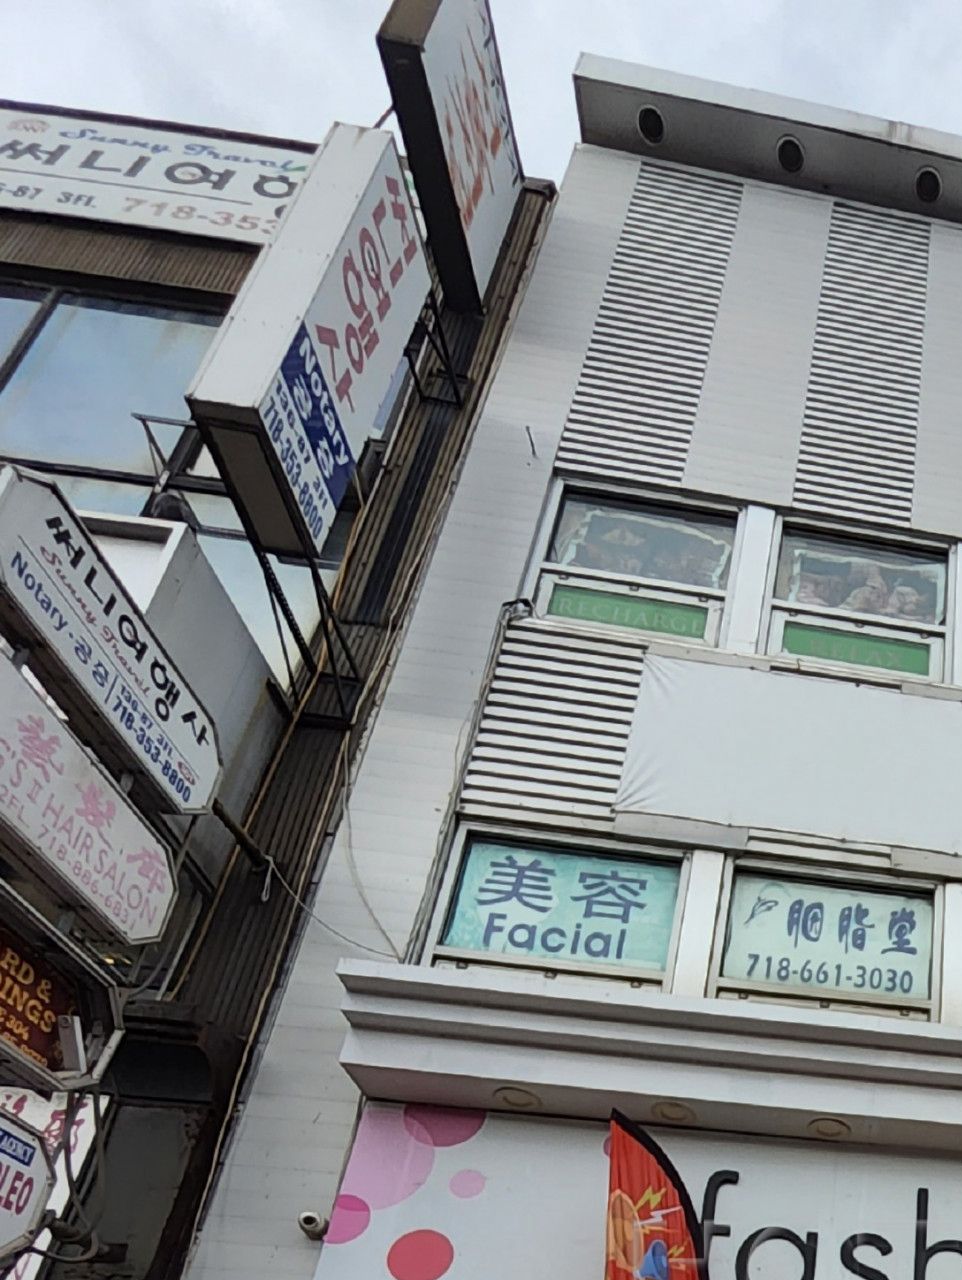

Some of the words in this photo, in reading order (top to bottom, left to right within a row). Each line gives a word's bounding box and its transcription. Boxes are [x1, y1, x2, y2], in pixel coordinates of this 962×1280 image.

[299, 336, 349, 467] Notary
[263, 399, 324, 540] 718-353-8800
[10, 551, 69, 632] Notary
[39, 546, 97, 628] Sunny
[45, 517, 210, 747] 써니여행사
[111, 695, 192, 803] 718-353-8800
[41, 793, 95, 863] HAIR
[94, 848, 158, 924] SALON
[477, 854, 650, 925] 美容
[483, 911, 627, 961] Facial
[746, 953, 914, 994] 718-661-3030
